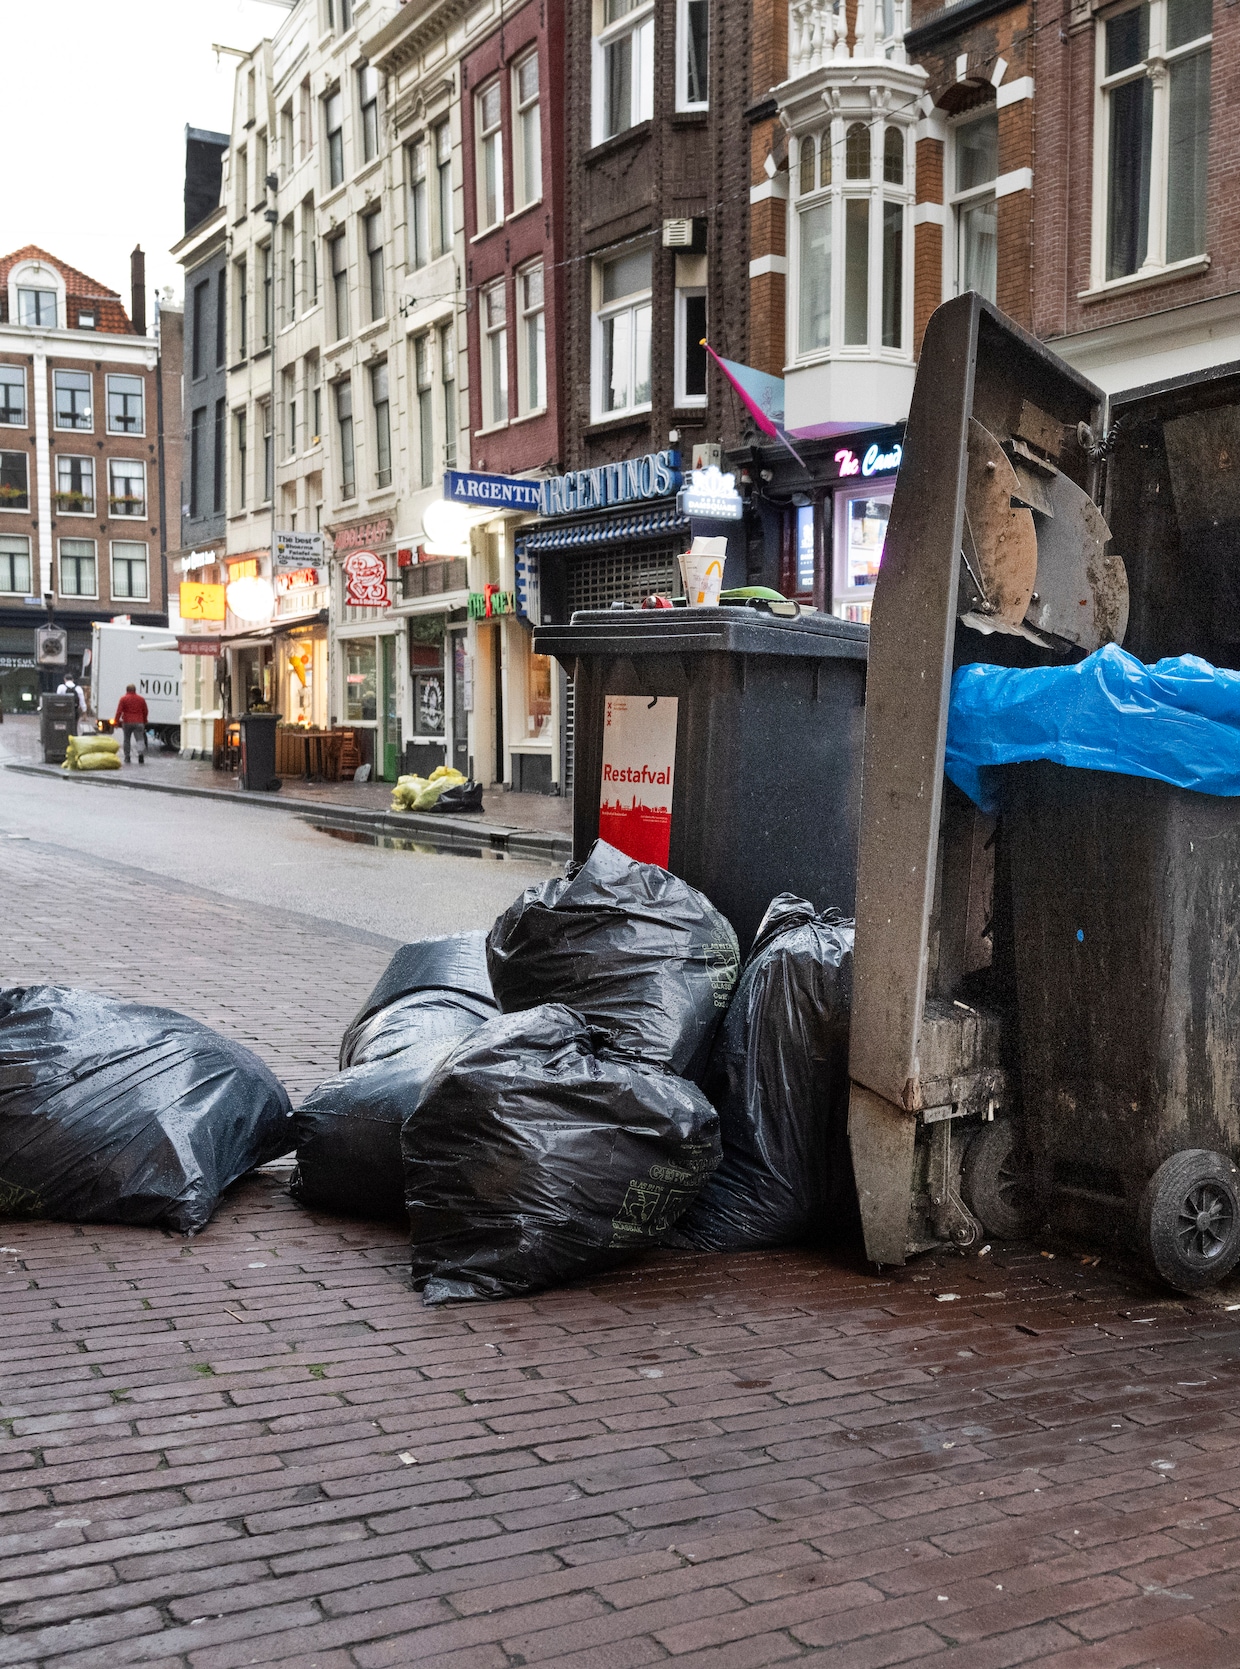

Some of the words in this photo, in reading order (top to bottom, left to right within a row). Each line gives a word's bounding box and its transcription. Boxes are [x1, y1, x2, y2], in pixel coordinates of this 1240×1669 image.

[834, 449, 859, 478] The
[538, 450, 677, 516] ARGENTINOS
[277, 535, 293, 543] The
[295, 536, 312, 545] best
[603, 764, 671, 785] Restafval
[629, 1179, 648, 1191] GLAS
